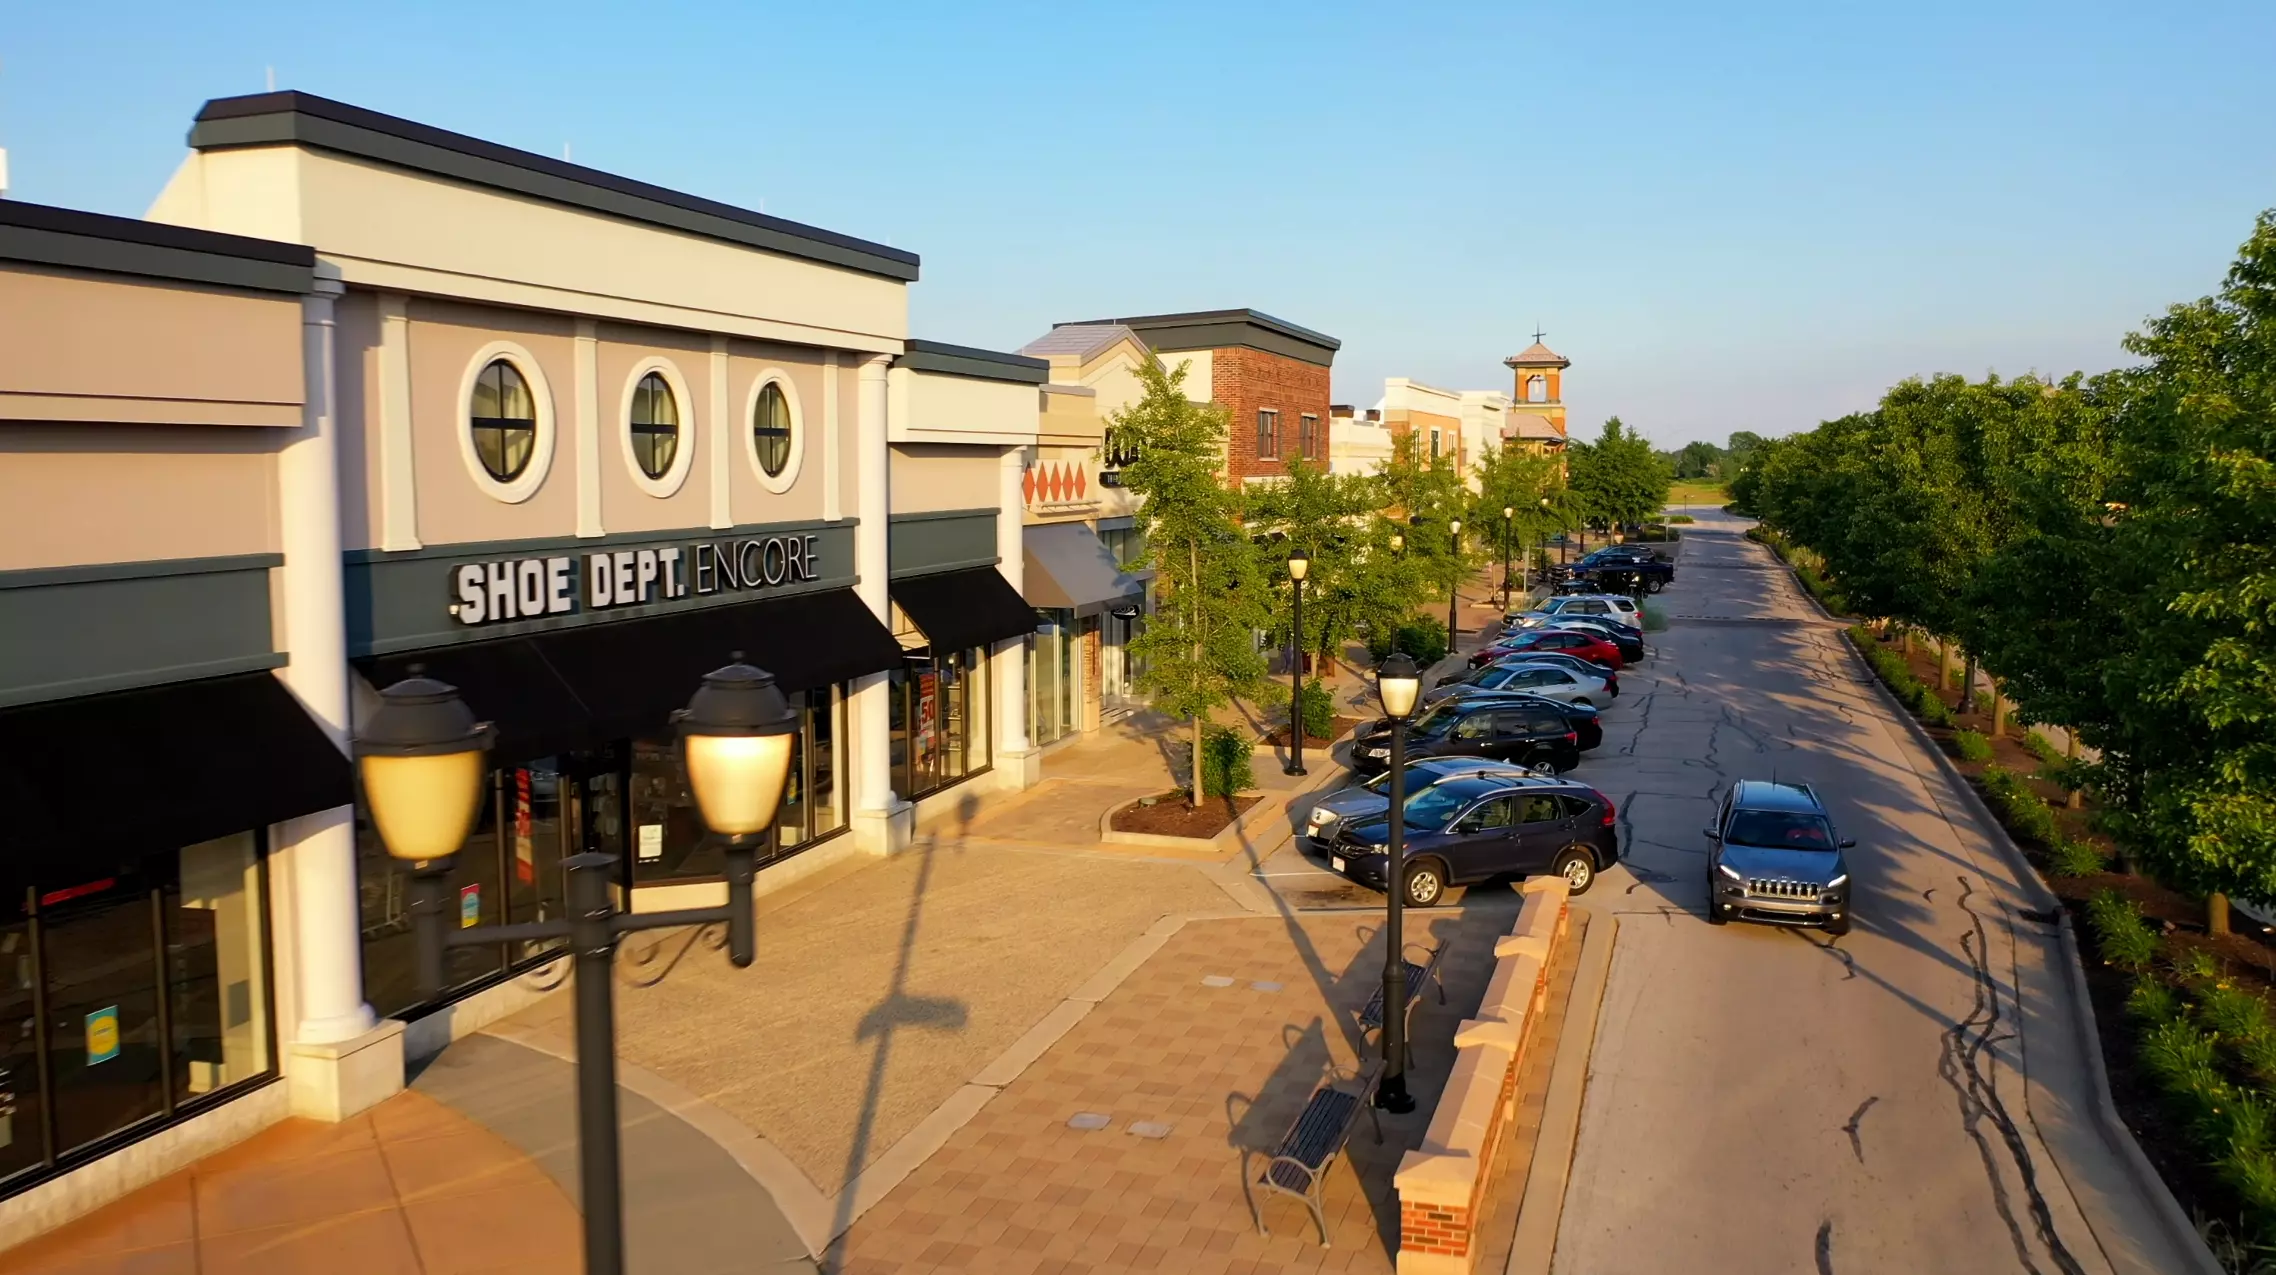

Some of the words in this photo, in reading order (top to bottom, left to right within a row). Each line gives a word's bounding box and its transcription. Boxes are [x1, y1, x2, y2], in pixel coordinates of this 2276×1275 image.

[457, 556, 572, 625] SHOE
[590, 547, 685, 608] DEPT.
[696, 534, 818, 594] ENCORE
